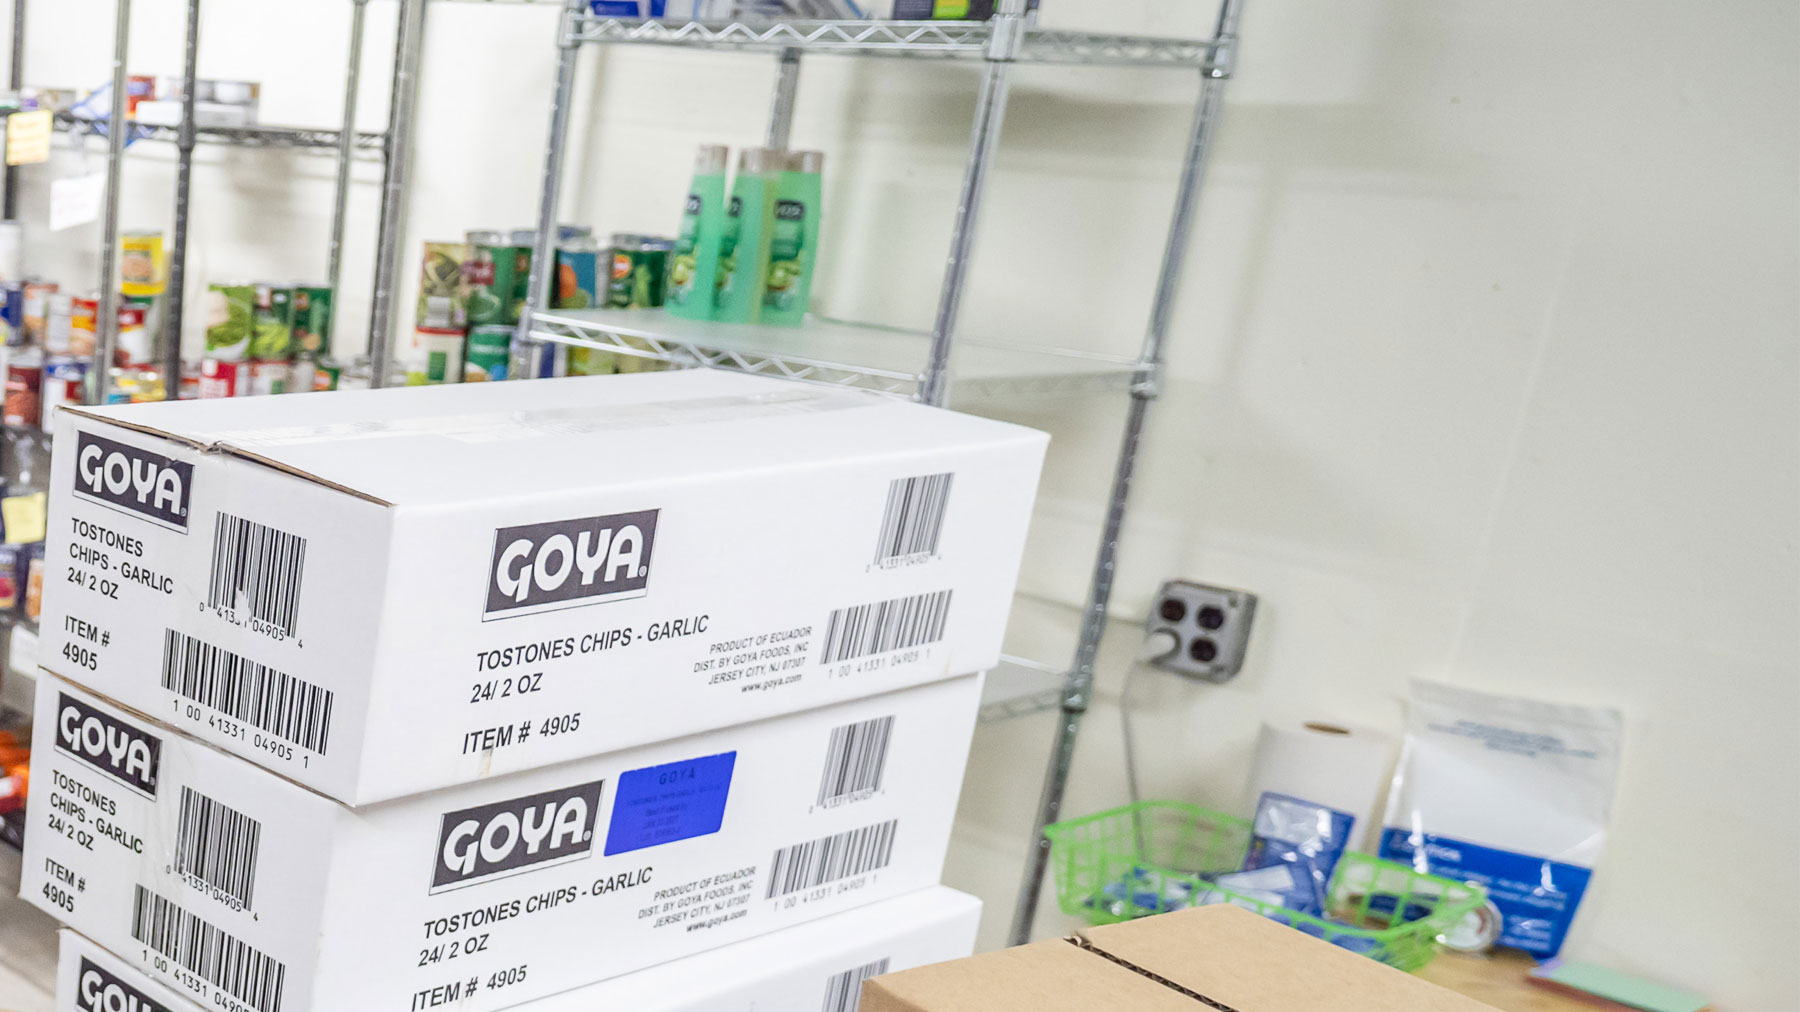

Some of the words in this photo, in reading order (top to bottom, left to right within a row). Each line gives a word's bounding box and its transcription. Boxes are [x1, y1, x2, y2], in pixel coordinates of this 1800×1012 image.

[79, 443, 183, 515] GOYA
[72, 518, 143, 557] TOSTONES
[67, 567, 85, 587] 24/
[89, 575, 97, 591] 2
[100, 581, 118, 599] OZ
[70, 543, 109, 571] CHIPS
[121, 562, 173, 595] GARLIC
[497, 524, 644, 603] GOYA
[65, 615, 97, 642] ITEM
[102, 630, 110, 647] #
[477, 638, 574, 672] TOSTONES
[580, 628, 632, 653] CHIPS
[647, 615, 709, 642] GARLIC
[710, 636, 753, 655] PRODUCT
[756, 634, 768, 646] OF
[770, 626, 812, 644] ECUADOR
[62, 642, 97, 671] 4905
[693, 658, 716, 673] DIST.
[718, 656, 731, 668] BY
[733, 651, 758, 667] GOYA
[760, 645, 791, 662] FOODS,
[793, 641, 809, 653] INC
[470, 680, 497, 704] 24/
[501, 678, 512, 698] 2
[518, 672, 543, 695] OZ
[741, 674, 802, 693] www.goya.com
[60, 705, 151, 783] GOYA
[463, 725, 513, 755] ITEM
[518, 721, 531, 744] #
[540, 713, 581, 737] 4905
[52, 770, 117, 816] TOSTONES
[659, 767, 695, 785] GOYA
[50, 792, 86, 824] CHIPS
[96, 817, 143, 854] GARLIC
[444, 796, 588, 876] GOYA
[45, 857, 75, 887] ITEM
[78, 876, 86, 893] #
[42, 882, 74, 913] 4905
[424, 900, 520, 939] TOSTONES
[526, 886, 577, 913] CHIPS
[592, 867, 653, 896] GARLIC
[411, 982, 460, 1012] ITEM
[465, 977, 478, 998] #
[487, 965, 527, 990] 4905
